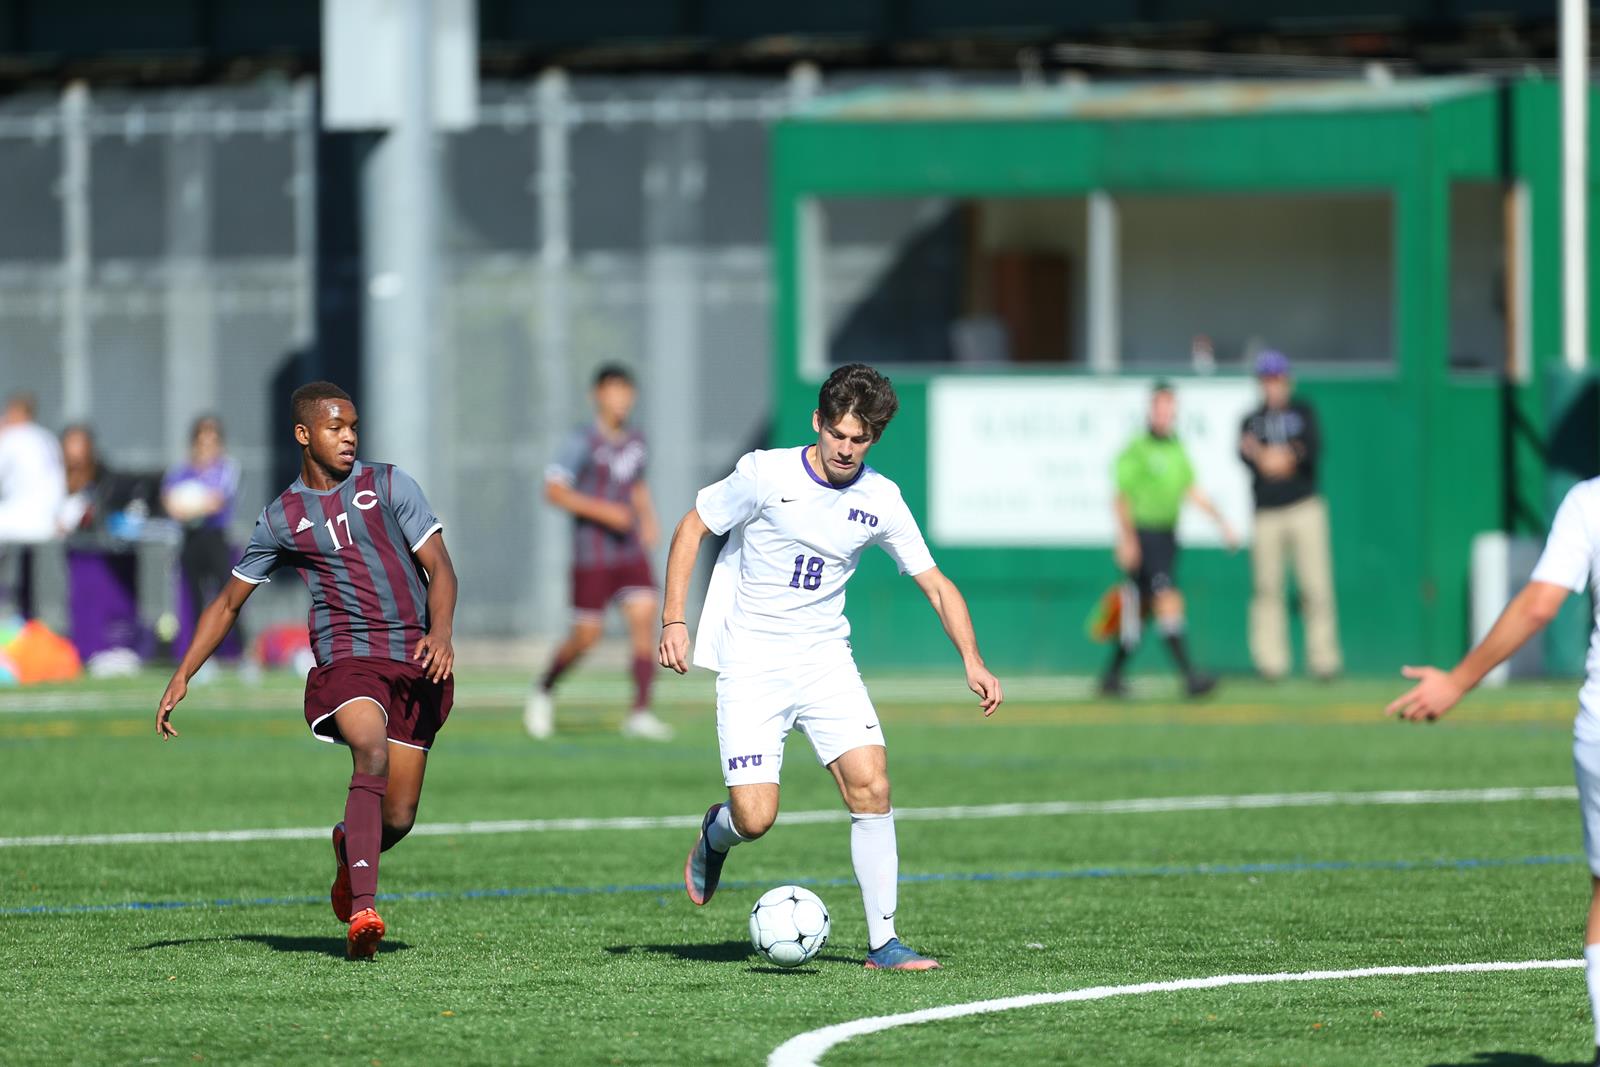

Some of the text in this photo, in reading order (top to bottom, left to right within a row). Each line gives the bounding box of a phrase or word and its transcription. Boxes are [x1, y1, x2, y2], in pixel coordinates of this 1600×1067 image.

[352, 490, 378, 510] C
[848, 508, 879, 528] NYU
[324, 511, 353, 552] 17
[789, 554, 825, 591] 18
[728, 754, 763, 771] NYU
